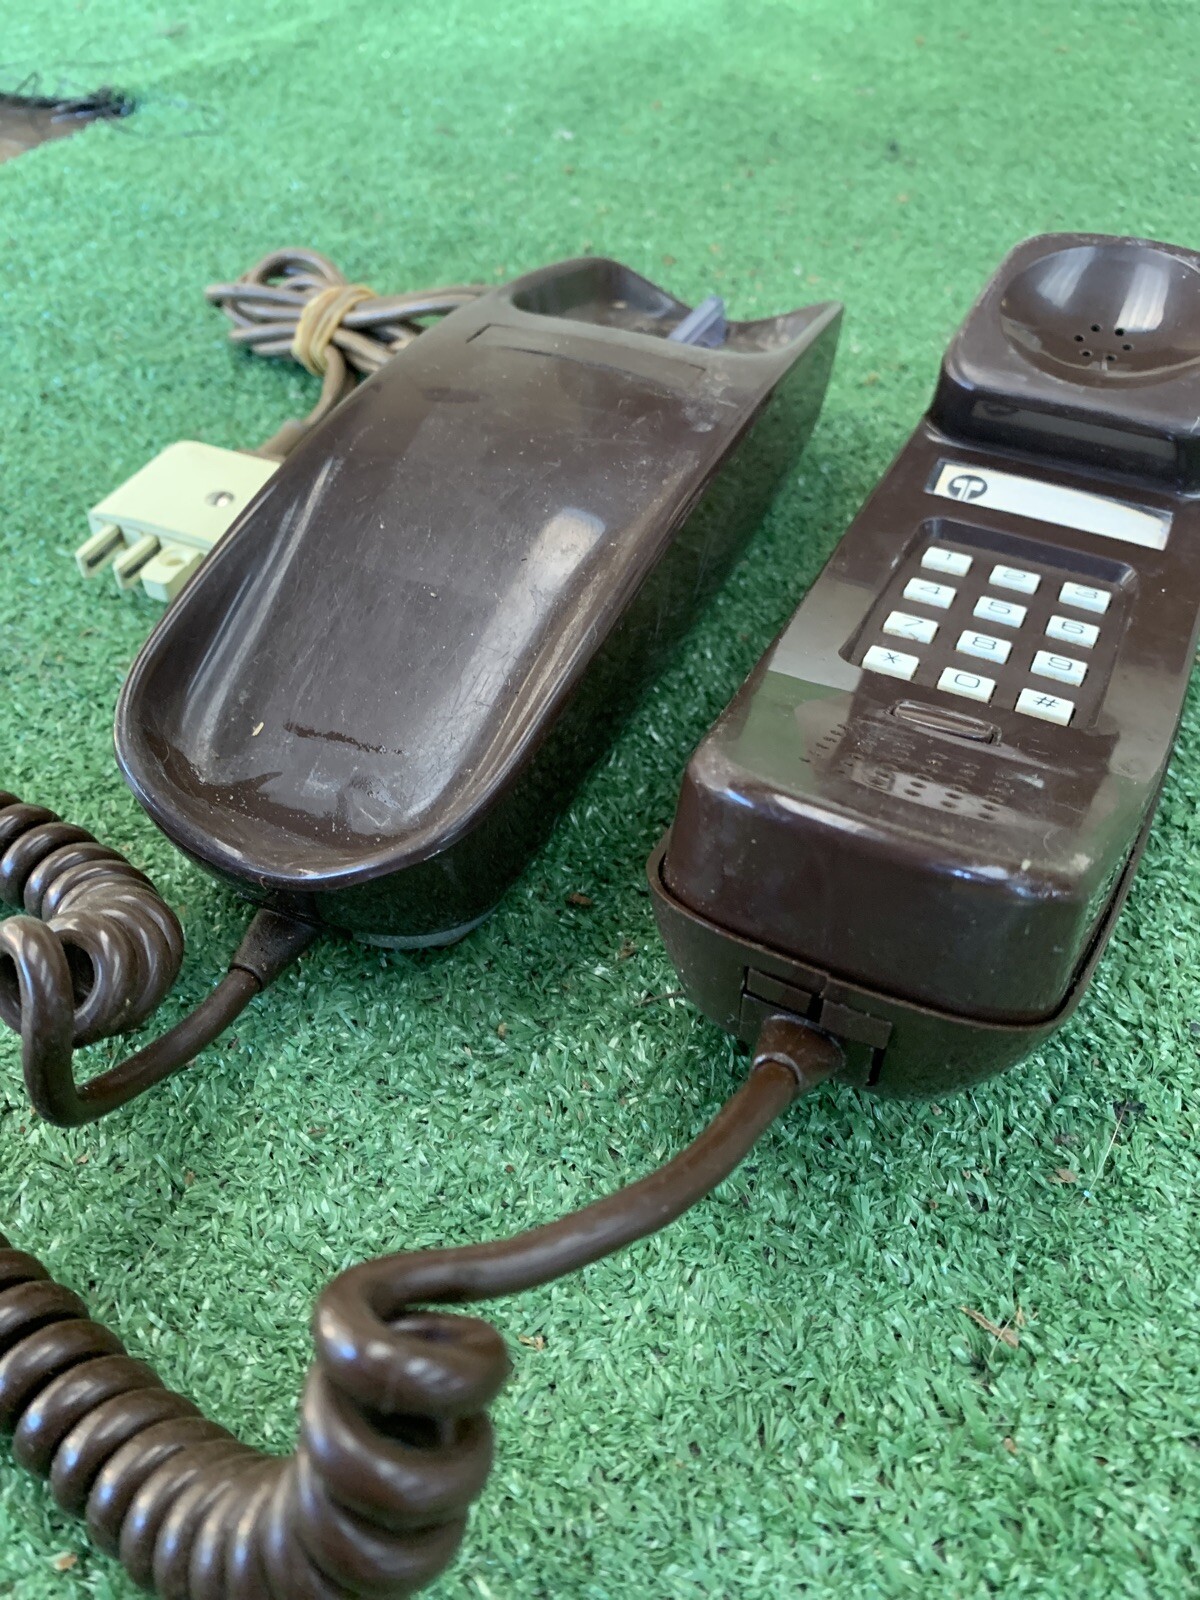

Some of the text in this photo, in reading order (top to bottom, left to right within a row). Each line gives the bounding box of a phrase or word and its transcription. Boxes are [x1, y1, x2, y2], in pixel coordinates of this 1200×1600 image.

[919, 585, 940, 595] 4
[1075, 586, 1099, 599] 3
[988, 600, 1011, 614] 5
[904, 616, 925, 628] 7
[1061, 620, 1085, 634] 6
[972, 635, 997, 650] 8
[1048, 656, 1073, 671] 9
[954, 673, 981, 689] 0
[1033, 696, 1060, 708] #
